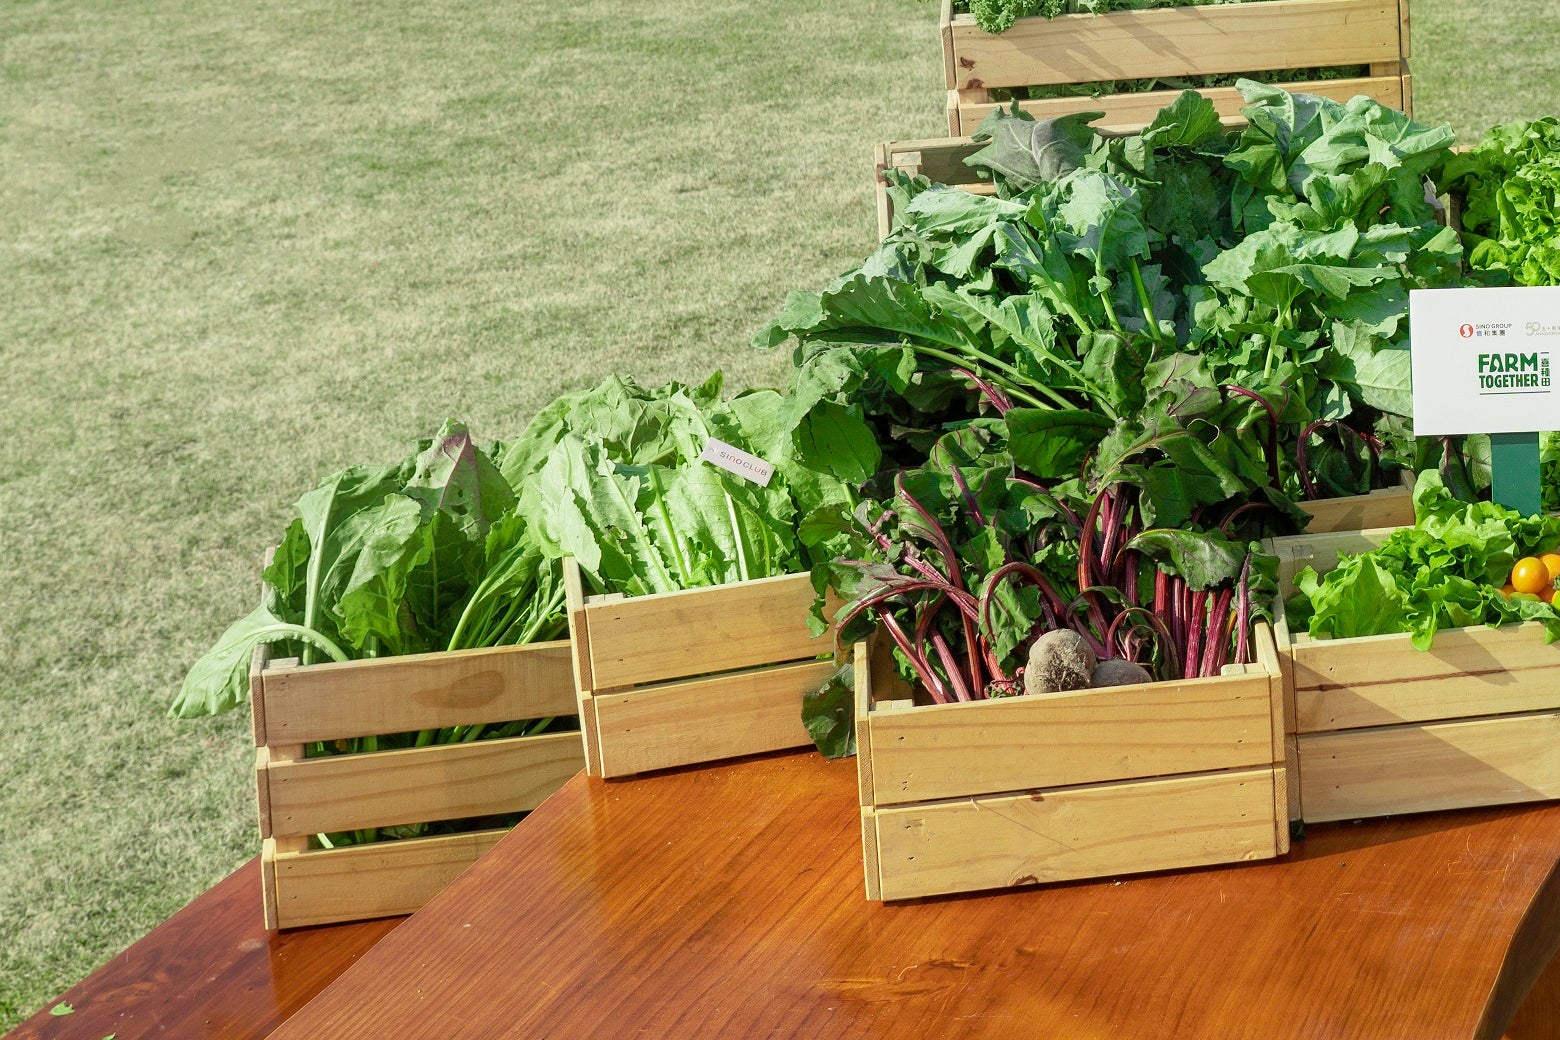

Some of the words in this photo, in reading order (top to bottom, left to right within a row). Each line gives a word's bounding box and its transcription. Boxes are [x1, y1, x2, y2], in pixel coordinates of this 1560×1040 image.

[1525, 321, 1541, 336] 50
[1478, 352, 1538, 373] FARM
[1479, 374, 1539, 388] TOGETHER
